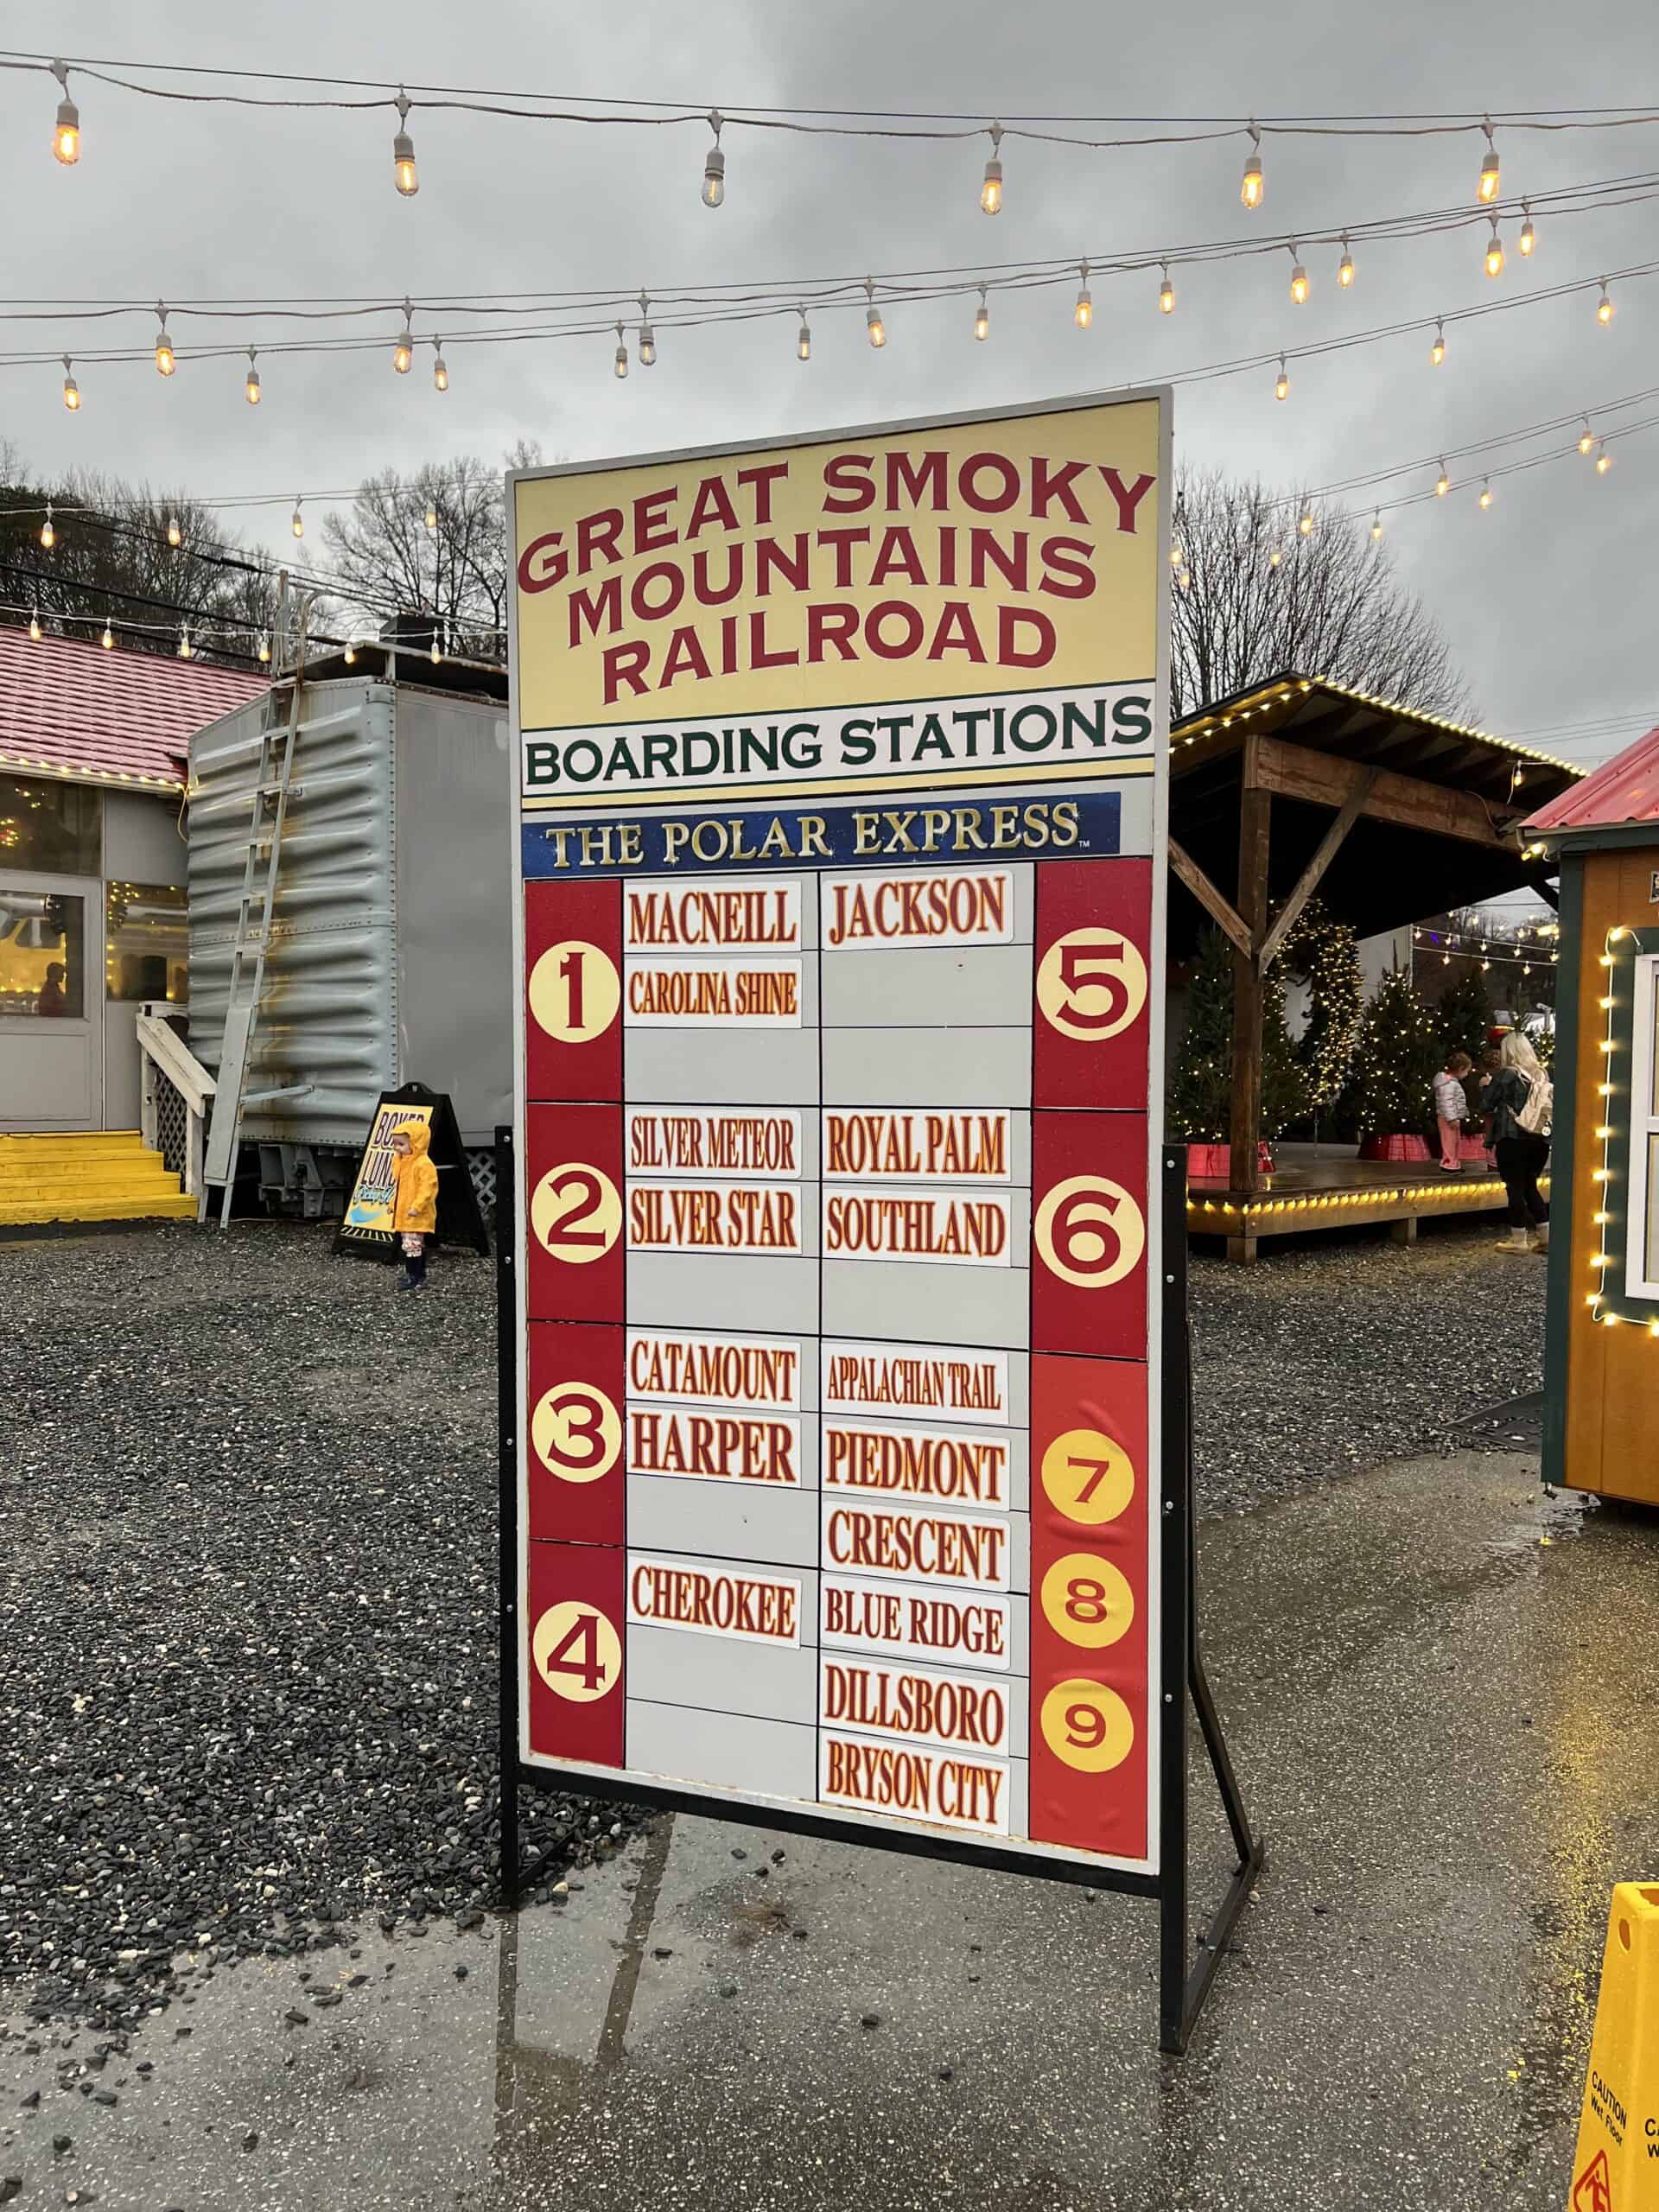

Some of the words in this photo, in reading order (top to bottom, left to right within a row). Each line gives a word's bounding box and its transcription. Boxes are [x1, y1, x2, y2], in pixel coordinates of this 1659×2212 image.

[518, 464, 788, 594] GREAT
[822, 451, 1157, 534] SMOKY
[569, 526, 1096, 648] MOUNTAINS
[602, 601, 1056, 705] RAILROAD
[526, 724, 823, 785] BOARDING
[840, 696, 1153, 766] STATIONS
[546, 824, 643, 867] THE
[662, 817, 833, 863] POLAR
[852, 803, 1078, 854] EXPRESS
[629, 891, 796, 944] MACNEILL
[829, 876, 1006, 945] JACKSON
[560, 951, 586, 1028] 1
[629, 971, 732, 1015] CAROLINA
[735, 972, 797, 1016] SHINE
[1056, 941, 1129, 1028] 5
[632, 1116, 702, 1167] SILVER
[707, 1118, 795, 1170] METEOR
[827, 1115, 921, 1173] ROYAL
[926, 1115, 1006, 1174] PALM
[548, 1171, 606, 1248] 2
[631, 1189, 724, 1245] SILVER
[728, 1190, 797, 1247] STAR
[828, 1198, 1005, 1257] SOUTHLAND
[1051, 1190, 1122, 1274] 6
[631, 1340, 796, 1402] CATAMOUNT
[829, 1356, 944, 1406] APPALACHIAN
[948, 1363, 1001, 1410] TRAIL
[546, 1393, 605, 1469] 3
[631, 1413, 796, 1482] HARPER
[826, 1430, 1005, 1502] PIEDMONT
[1068, 1457, 1109, 1503] 7
[829, 1510, 1004, 1581] CRESCENT
[632, 1565, 795, 1638] CHEROKEE
[827, 1589, 901, 1641] BLUE
[909, 1599, 1003, 1656] RIDGE
[1066, 1579, 1107, 1623] 8
[546, 1613, 605, 1690] 4
[824, 1664, 1003, 1746] DILLSBORO
[1065, 1704, 1106, 1748] 9
[826, 1740, 932, 1813] BRYSON
[938, 1760, 1003, 1825] CITY
[1592, 2070, 1627, 2130] CAUTION
[1592, 2094, 1604, 2120] Wet
[1605, 2115, 1622, 2147] Floor
[1645, 2118, 1659, 2137] C
